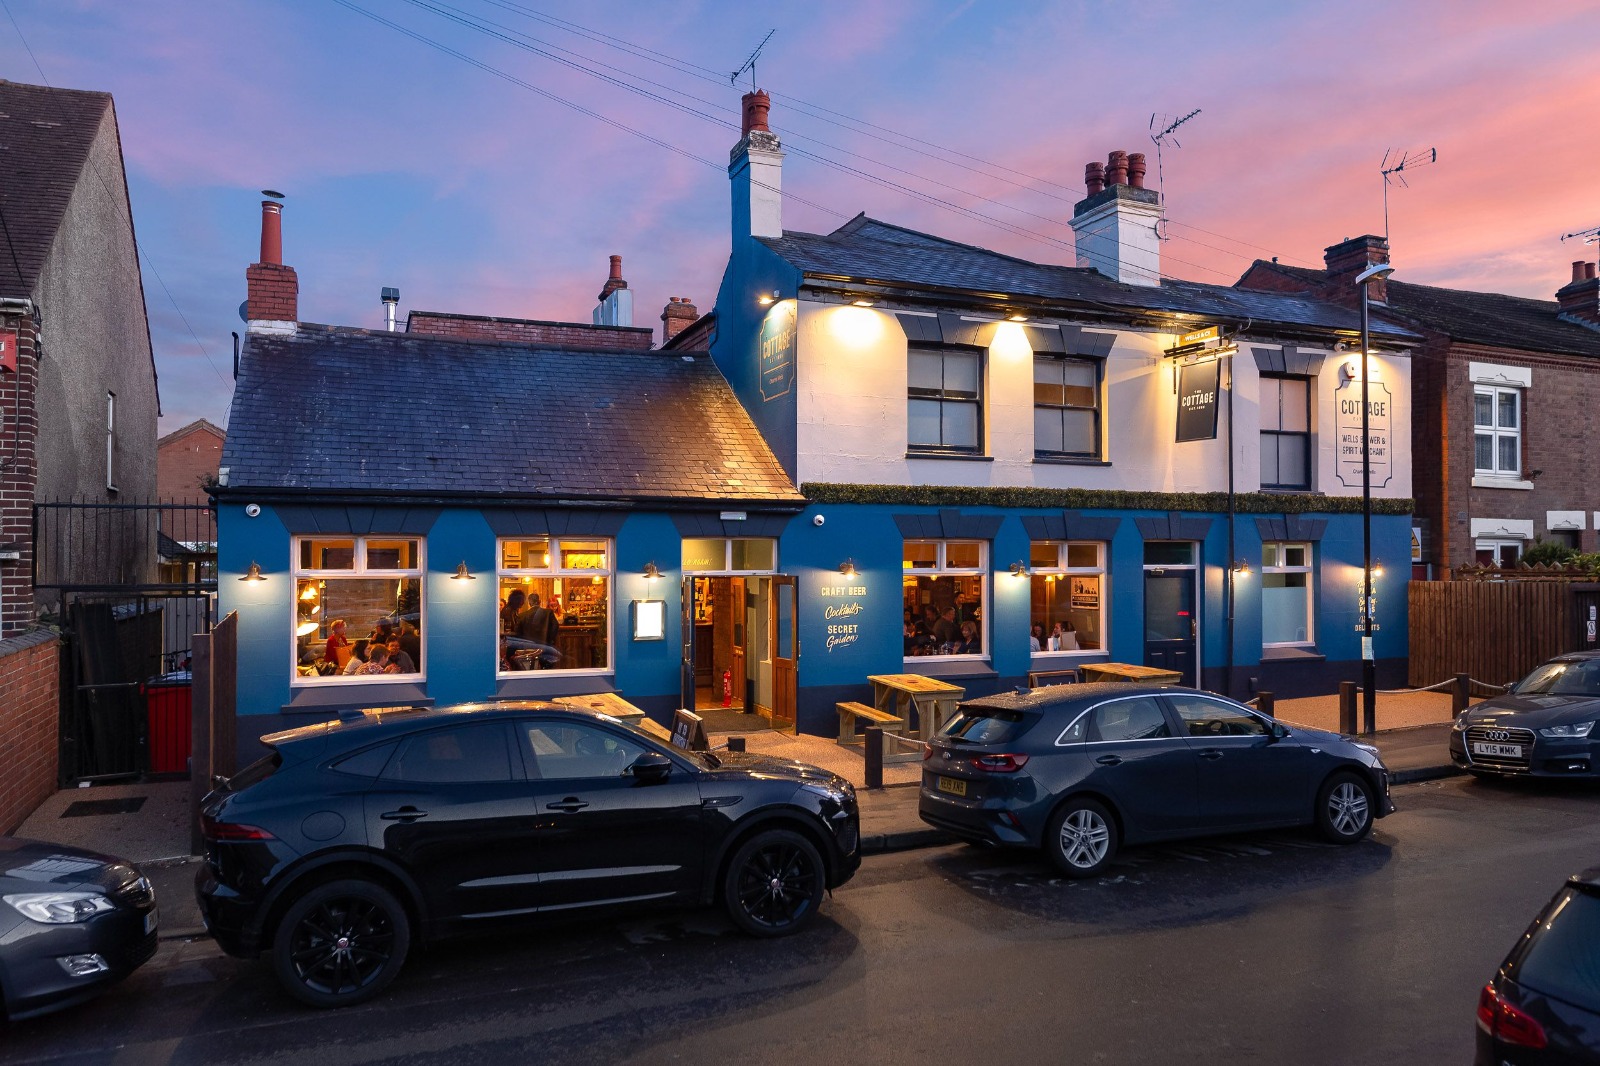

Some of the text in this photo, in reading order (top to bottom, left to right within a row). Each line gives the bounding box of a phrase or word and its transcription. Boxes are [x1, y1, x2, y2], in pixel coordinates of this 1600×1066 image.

[1184, 332, 1201, 342] WELLS
[1182, 391, 1214, 407] COTTAGE
[1341, 399, 1386, 417] COTAGE
[1341, 434, 1359, 444] WELLS
[1382, 437, 1386, 445] &
[821, 586, 867, 596] CRAFT BEER
[825, 602, 864, 619] Cocktails
[827, 624, 859, 635] SECRET
[826, 633, 859, 653] Garden
[1479, 743, 1517, 756] LY15 WMK
